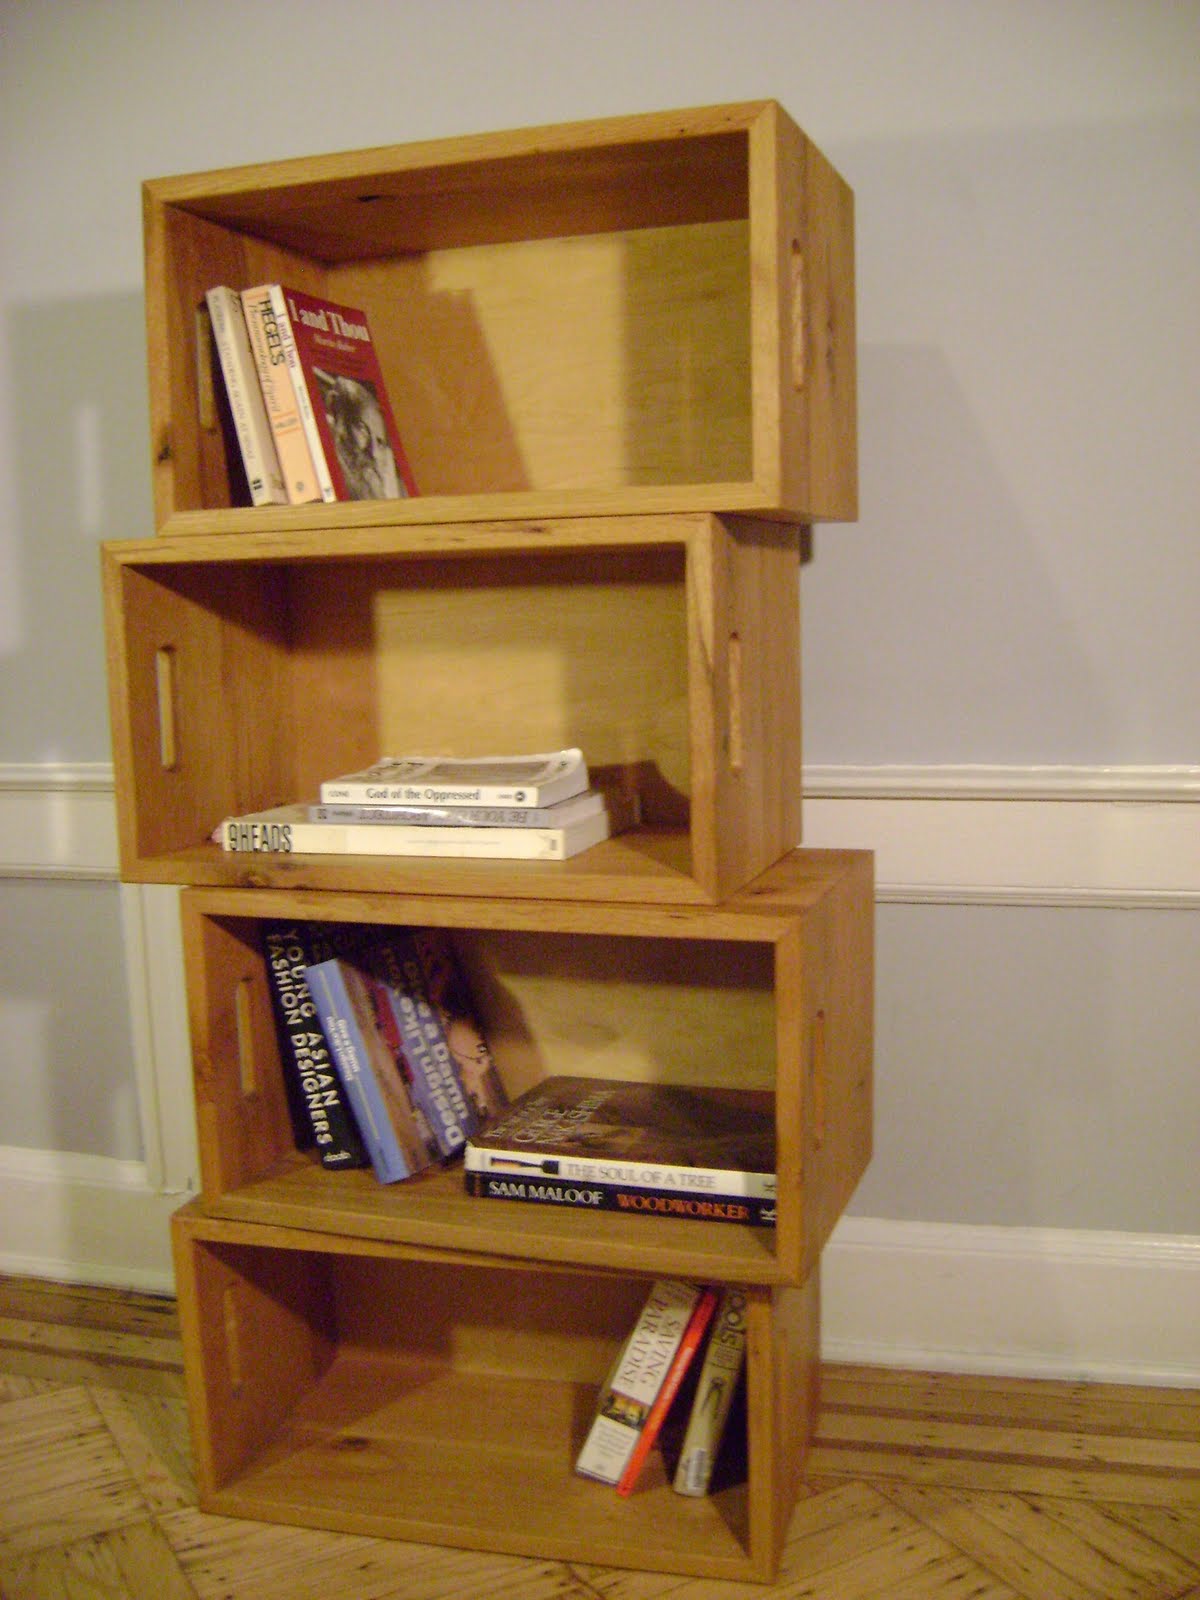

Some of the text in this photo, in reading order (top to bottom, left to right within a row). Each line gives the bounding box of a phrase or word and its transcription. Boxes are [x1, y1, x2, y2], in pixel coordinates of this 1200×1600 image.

[278, 321, 290, 340] and
[289, 299, 371, 342] I and Thou
[283, 343, 298, 368] Thou
[366, 787, 480, 803] God of the Oppressed
[267, 934, 332, 1145] FASHION DESIGNERS
[284, 929, 340, 1106] YOUNG ASIAN
[400, 995, 426, 1055] Like
[419, 1055, 466, 1146] Design
[423, 1021, 438, 1040] a
[437, 1042, 470, 1120] Damn
[488, 1181, 750, 1220] SAM MALOOF WOODWORKER
[567, 1163, 717, 1189] THE SOUL OF A TREE
[620, 1297, 669, 1385] PARADISE
[641, 1318, 681, 1385] SAVING
